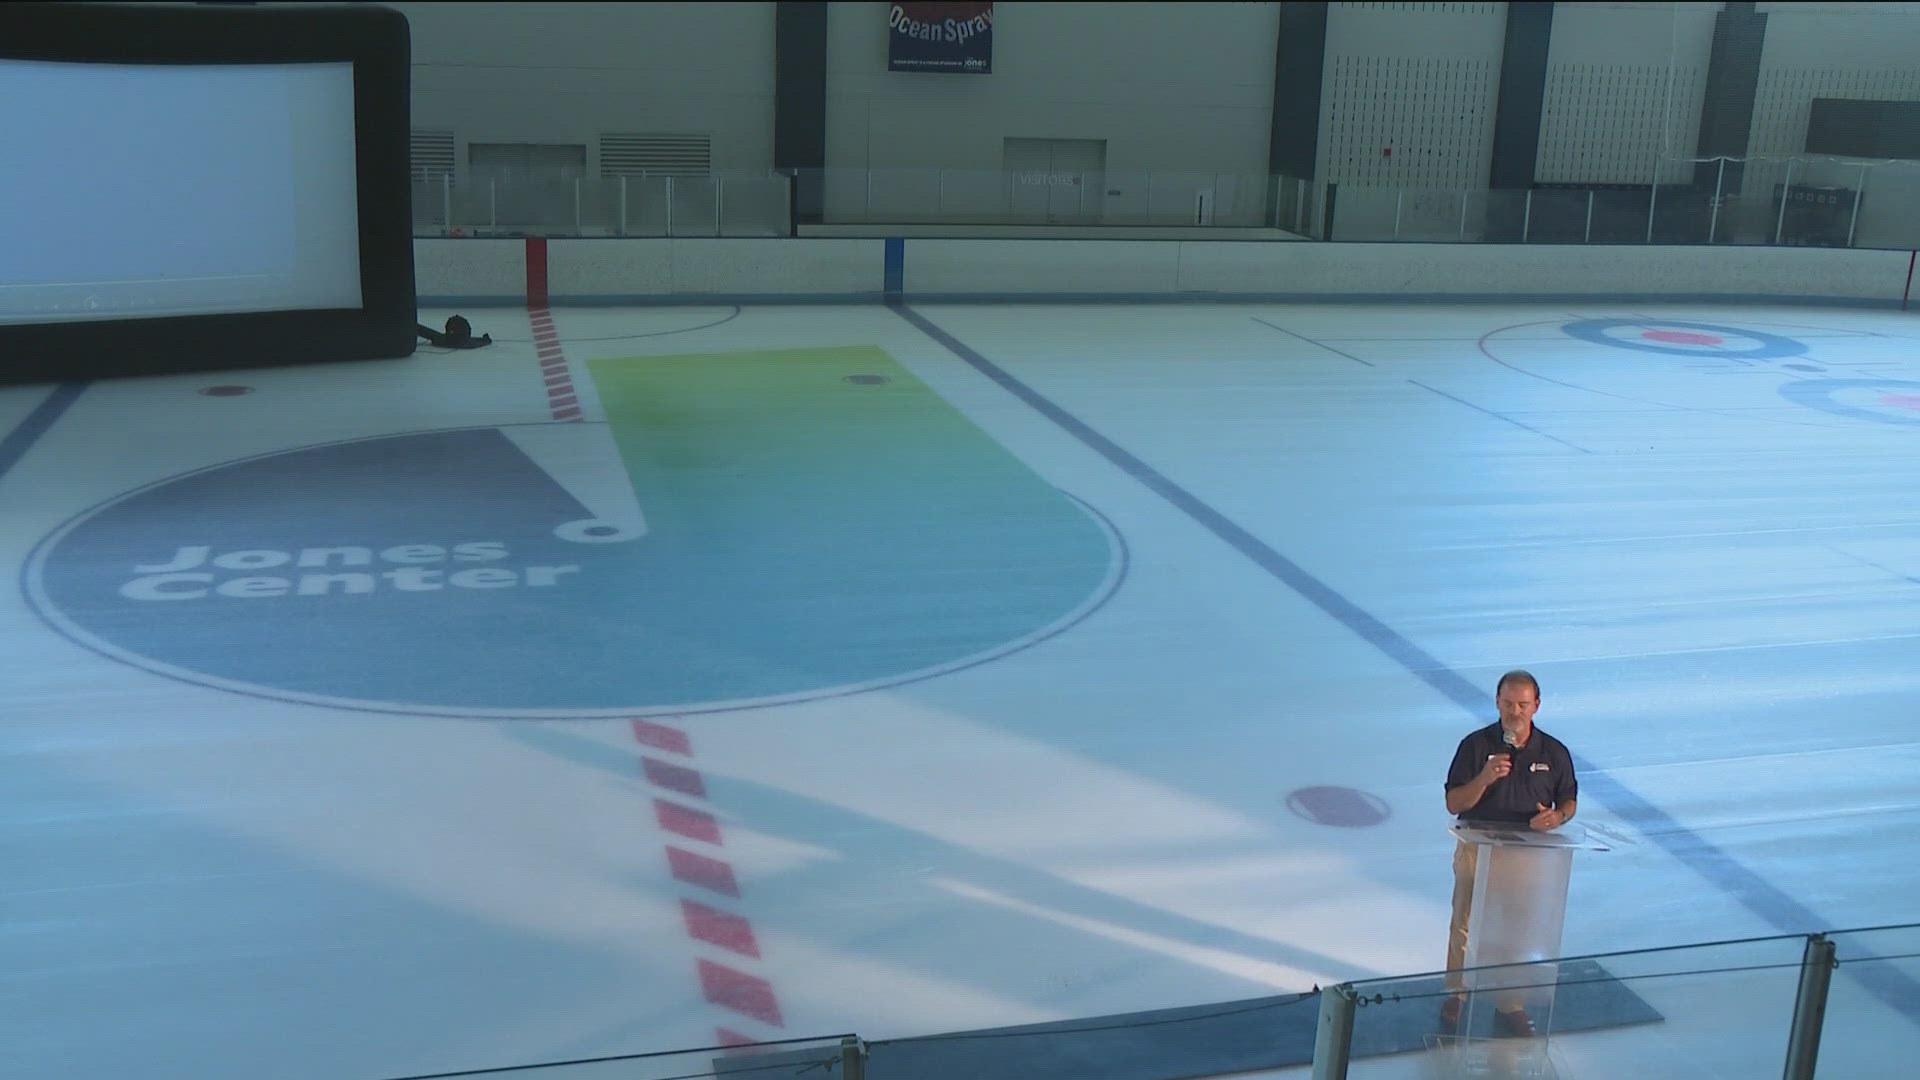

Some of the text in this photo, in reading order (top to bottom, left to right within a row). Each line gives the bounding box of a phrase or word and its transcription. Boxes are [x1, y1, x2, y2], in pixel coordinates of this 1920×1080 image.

[889, 5, 993, 44] Ocean Spray
[1020, 174, 1074, 185] VISITORS
[134, 542, 508, 573] Jones
[119, 565, 580, 600] Center
